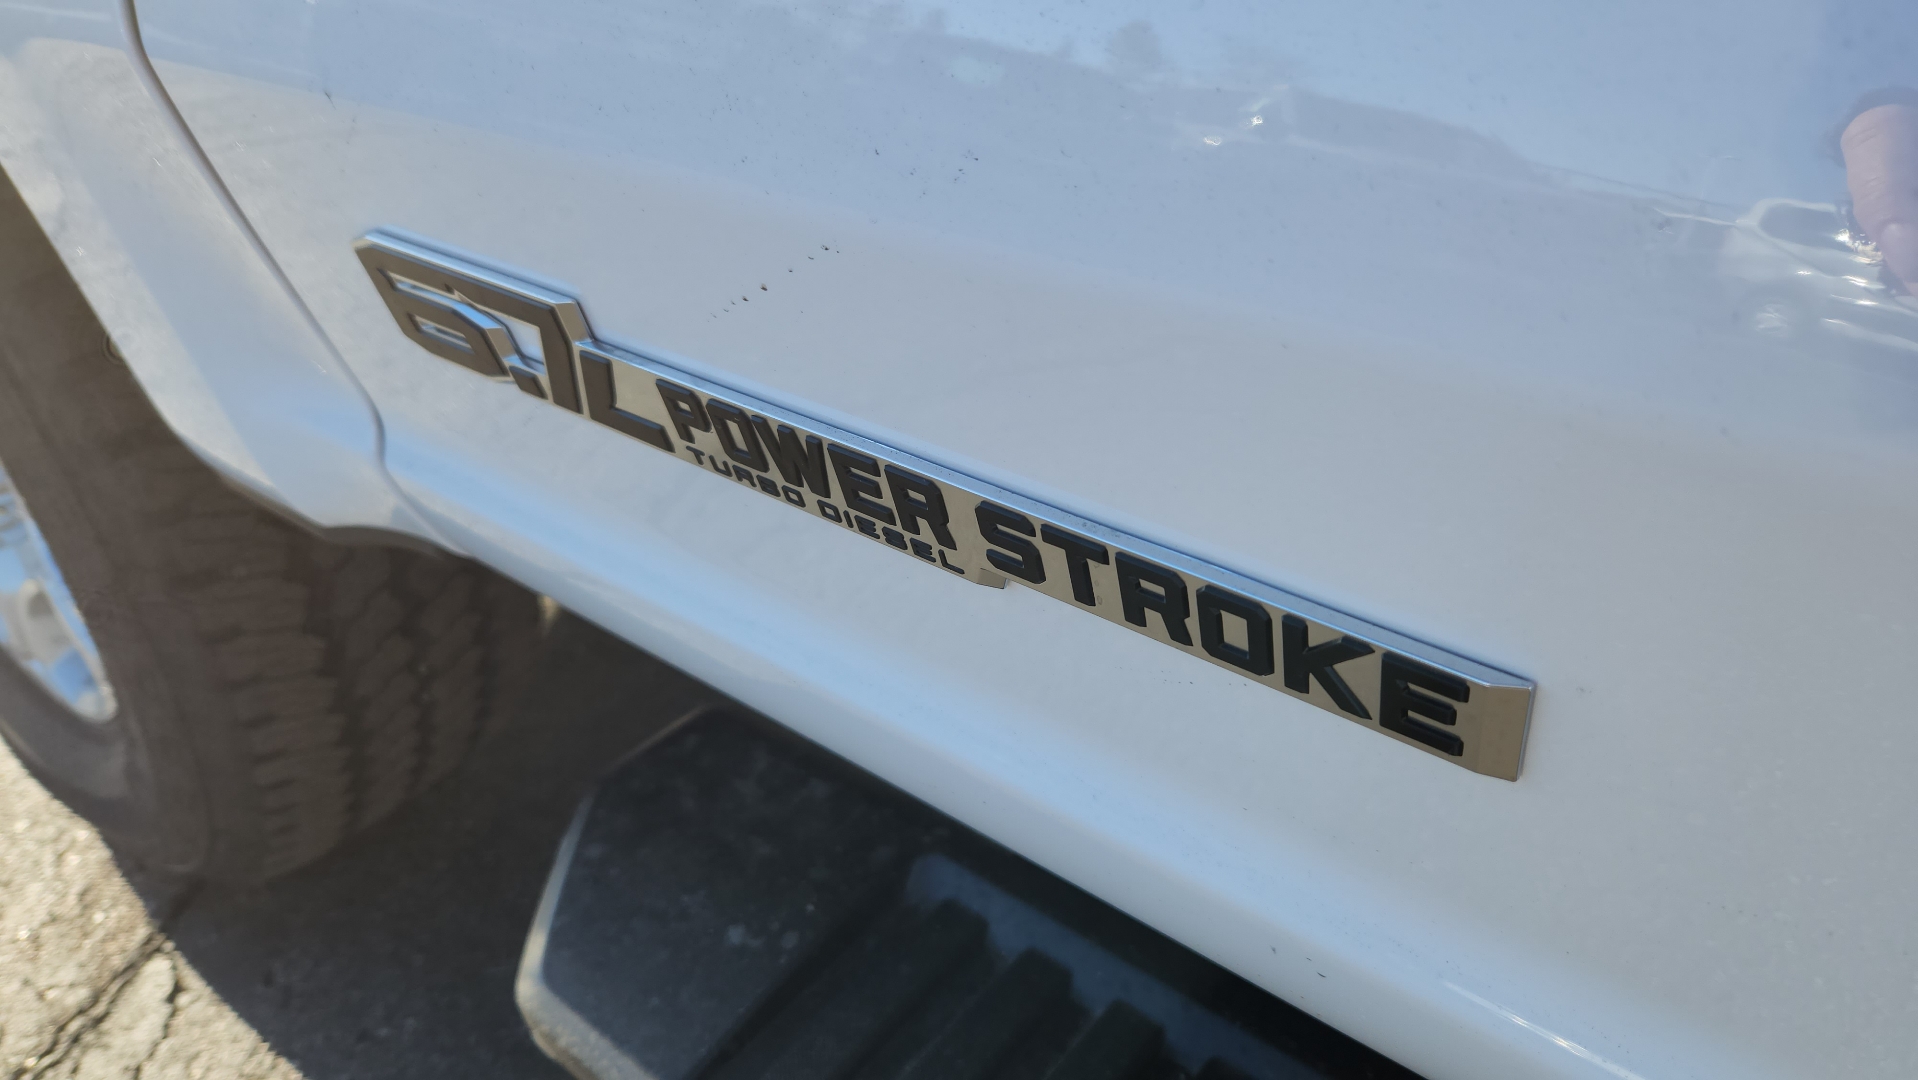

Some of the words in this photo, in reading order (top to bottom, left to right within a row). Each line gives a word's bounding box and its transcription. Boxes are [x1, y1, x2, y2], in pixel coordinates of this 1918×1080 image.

[354, 243, 676, 453] 6.7L
[656, 378, 957, 550] POWER
[975, 500, 1470, 757] STROKE
[685, 445, 806, 508] TURBO
[817, 499, 965, 575] DIESEL
